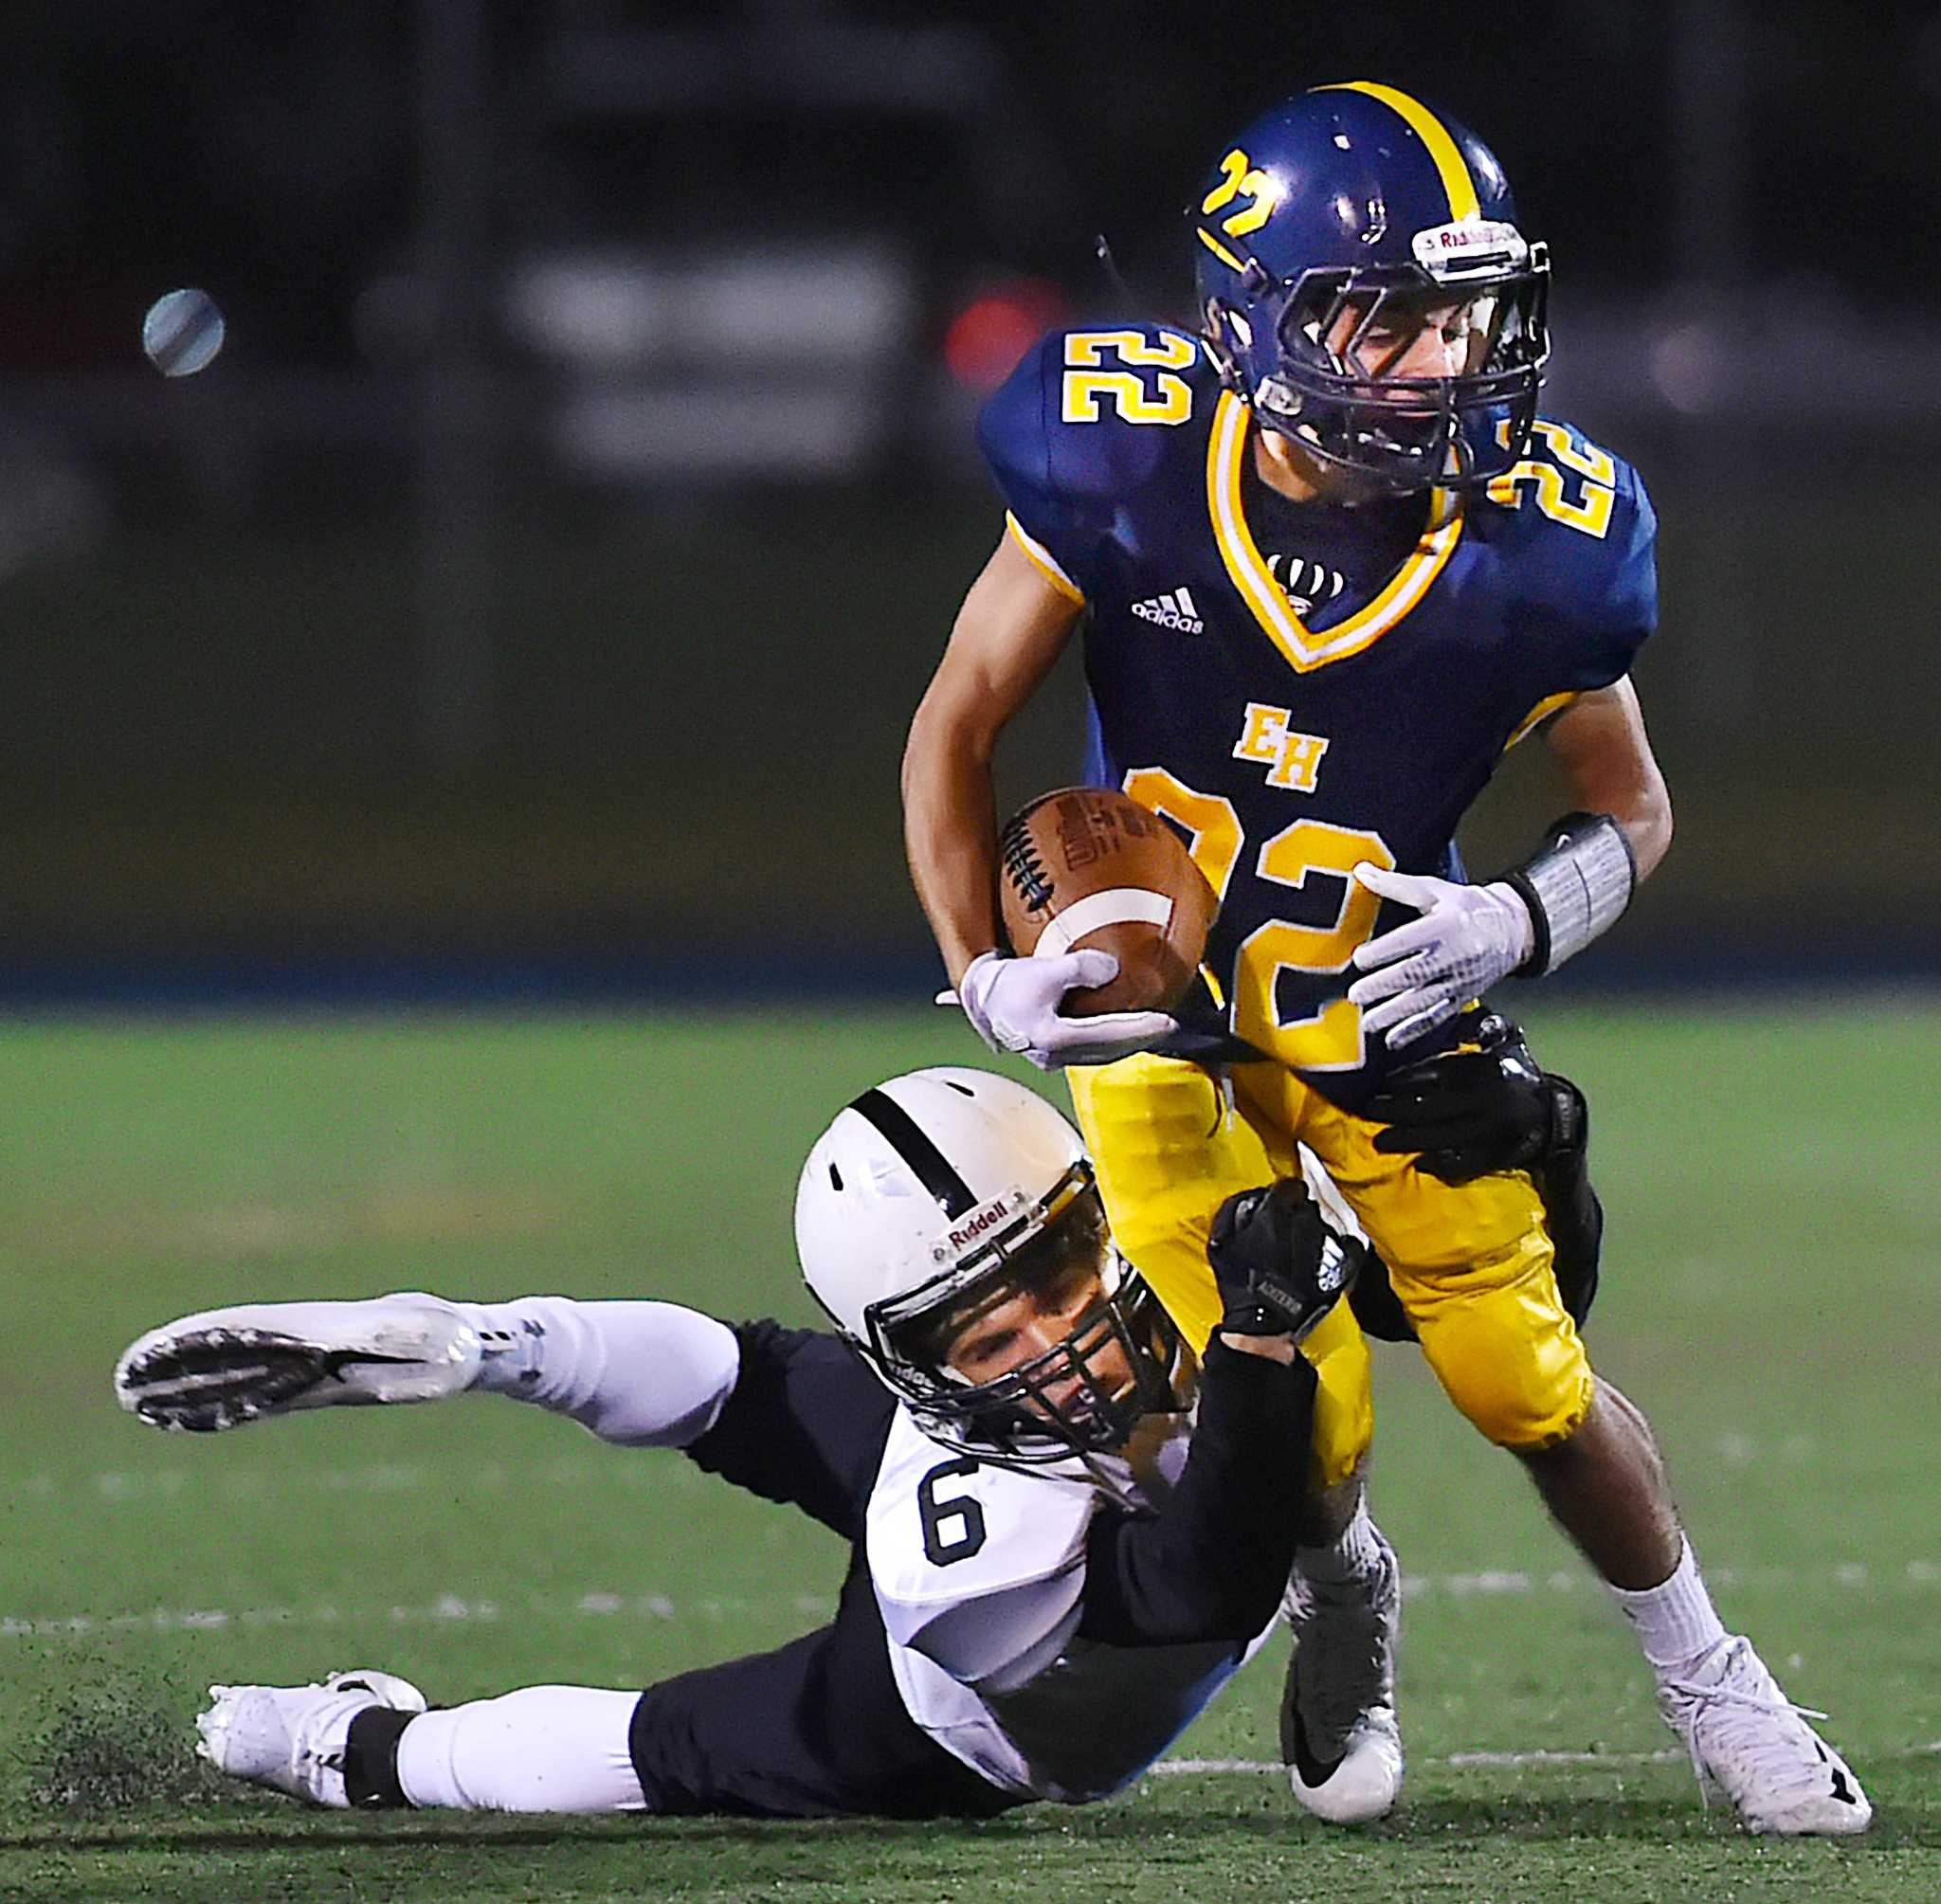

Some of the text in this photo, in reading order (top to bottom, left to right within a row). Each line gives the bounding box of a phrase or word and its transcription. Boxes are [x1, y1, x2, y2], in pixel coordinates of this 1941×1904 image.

[1061, 330, 1196, 426] 22
[1486, 419, 1616, 539] 22
[1131, 602, 1204, 635] adidas
[1233, 702, 1329, 794] EH
[948, 1200, 1009, 1252] Riddell
[916, 1459, 987, 1568] 6
